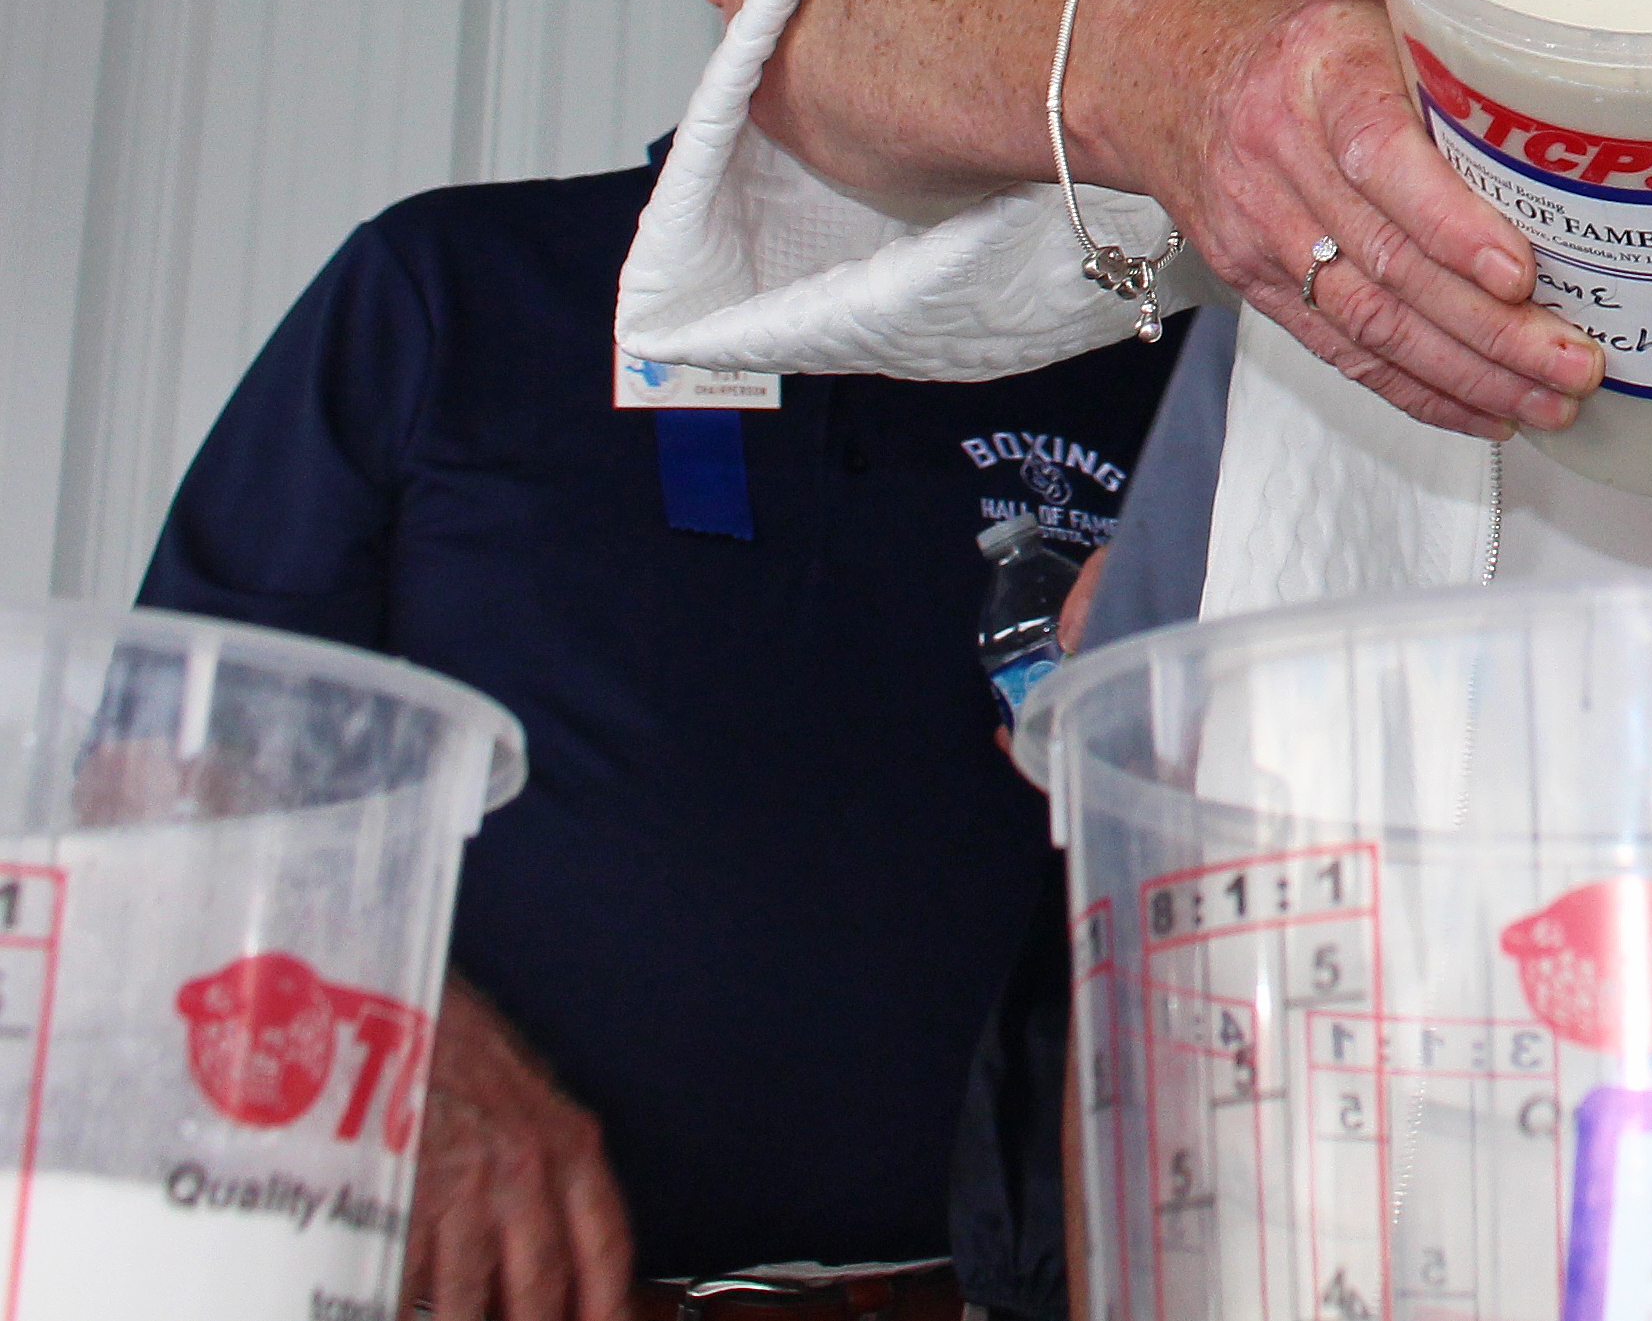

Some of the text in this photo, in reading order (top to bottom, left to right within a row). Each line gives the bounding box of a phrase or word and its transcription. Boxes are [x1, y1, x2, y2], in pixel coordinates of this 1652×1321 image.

[1446, 146, 1510, 207] HALL
[1515, 198, 1556, 227] OF
[1515, 185, 1566, 215] Boxing
[1619, 251, 1642, 264] NY
[960, 431, 1127, 493] BOXING
[979, 497, 1030, 521] HALL
[1037, 505, 1065, 526] OF
[166, 1160, 328, 1232] Quality
